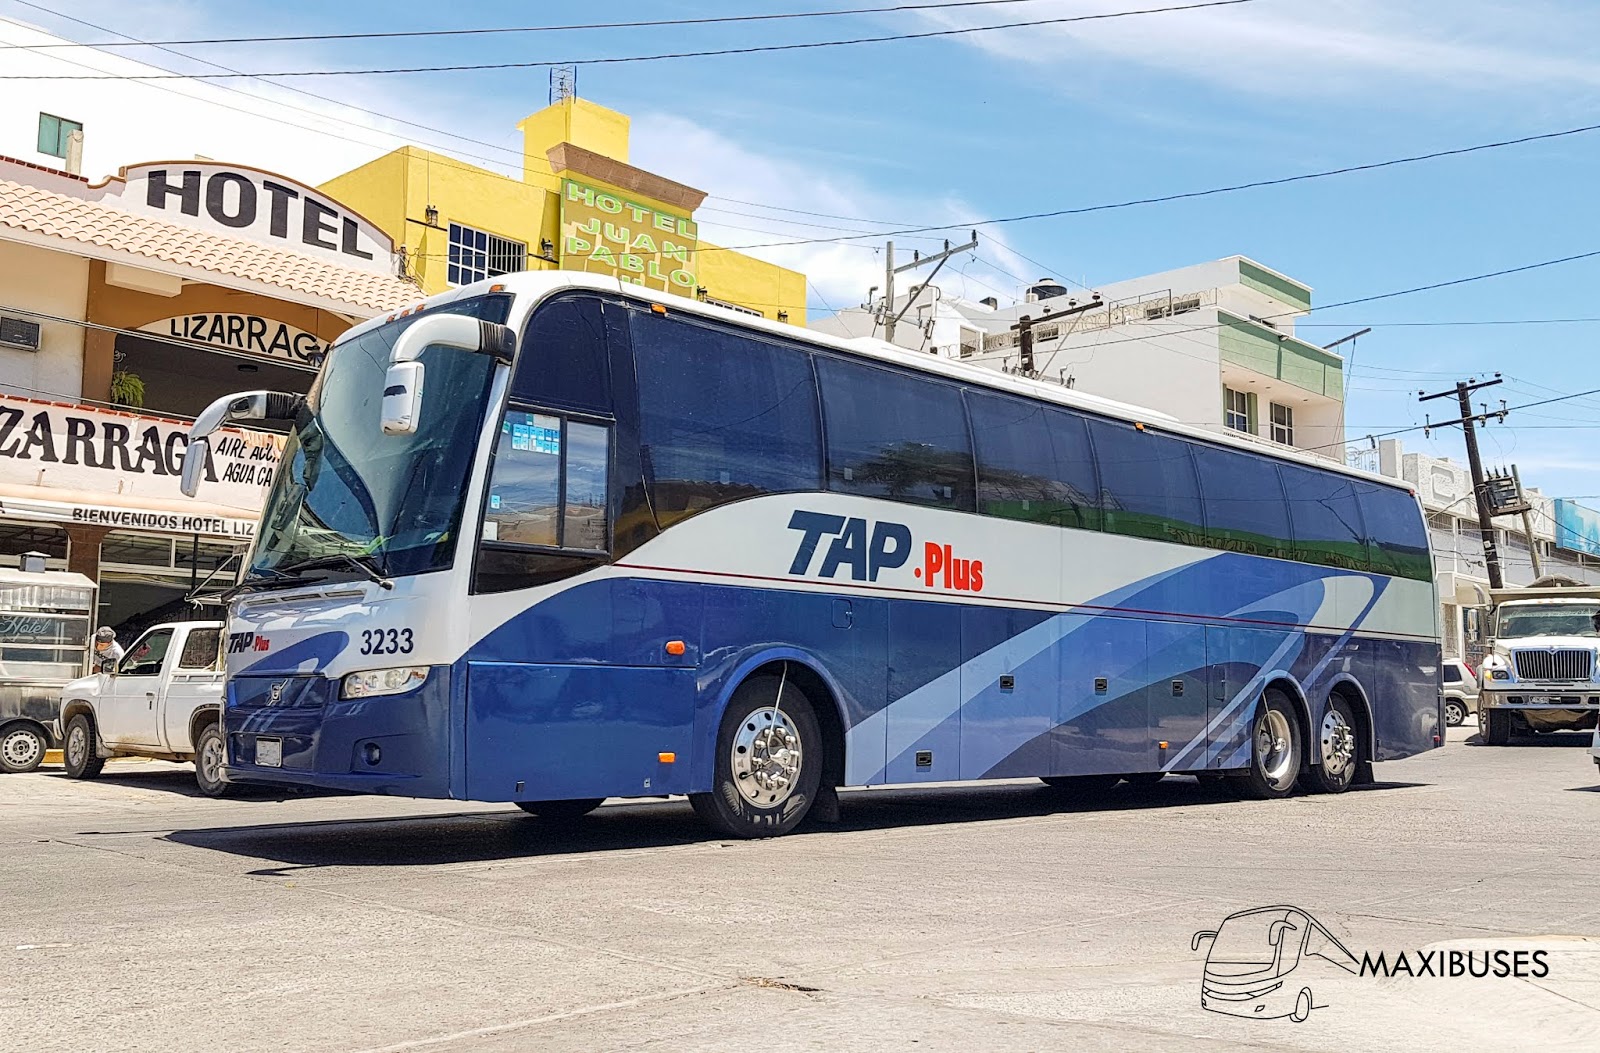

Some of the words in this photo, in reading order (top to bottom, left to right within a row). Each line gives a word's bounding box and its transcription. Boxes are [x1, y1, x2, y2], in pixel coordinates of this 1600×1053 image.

[147, 170, 373, 260] HOTEL
[567, 182, 697, 240] HOTEL
[566, 236, 696, 288] PABLO
[577, 218, 688, 262] JUAN
[170, 314, 331, 361] LIZARRAG
[215, 437, 248, 459] AIRE
[222, 462, 256, 485] AGUA
[72, 508, 178, 530] BIENVENIDOS
[182, 517, 229, 534] HOTEL
[787, 509, 912, 582] TAP
[228, 631, 254, 654] TAP
[360, 627, 414, 655] 3233
